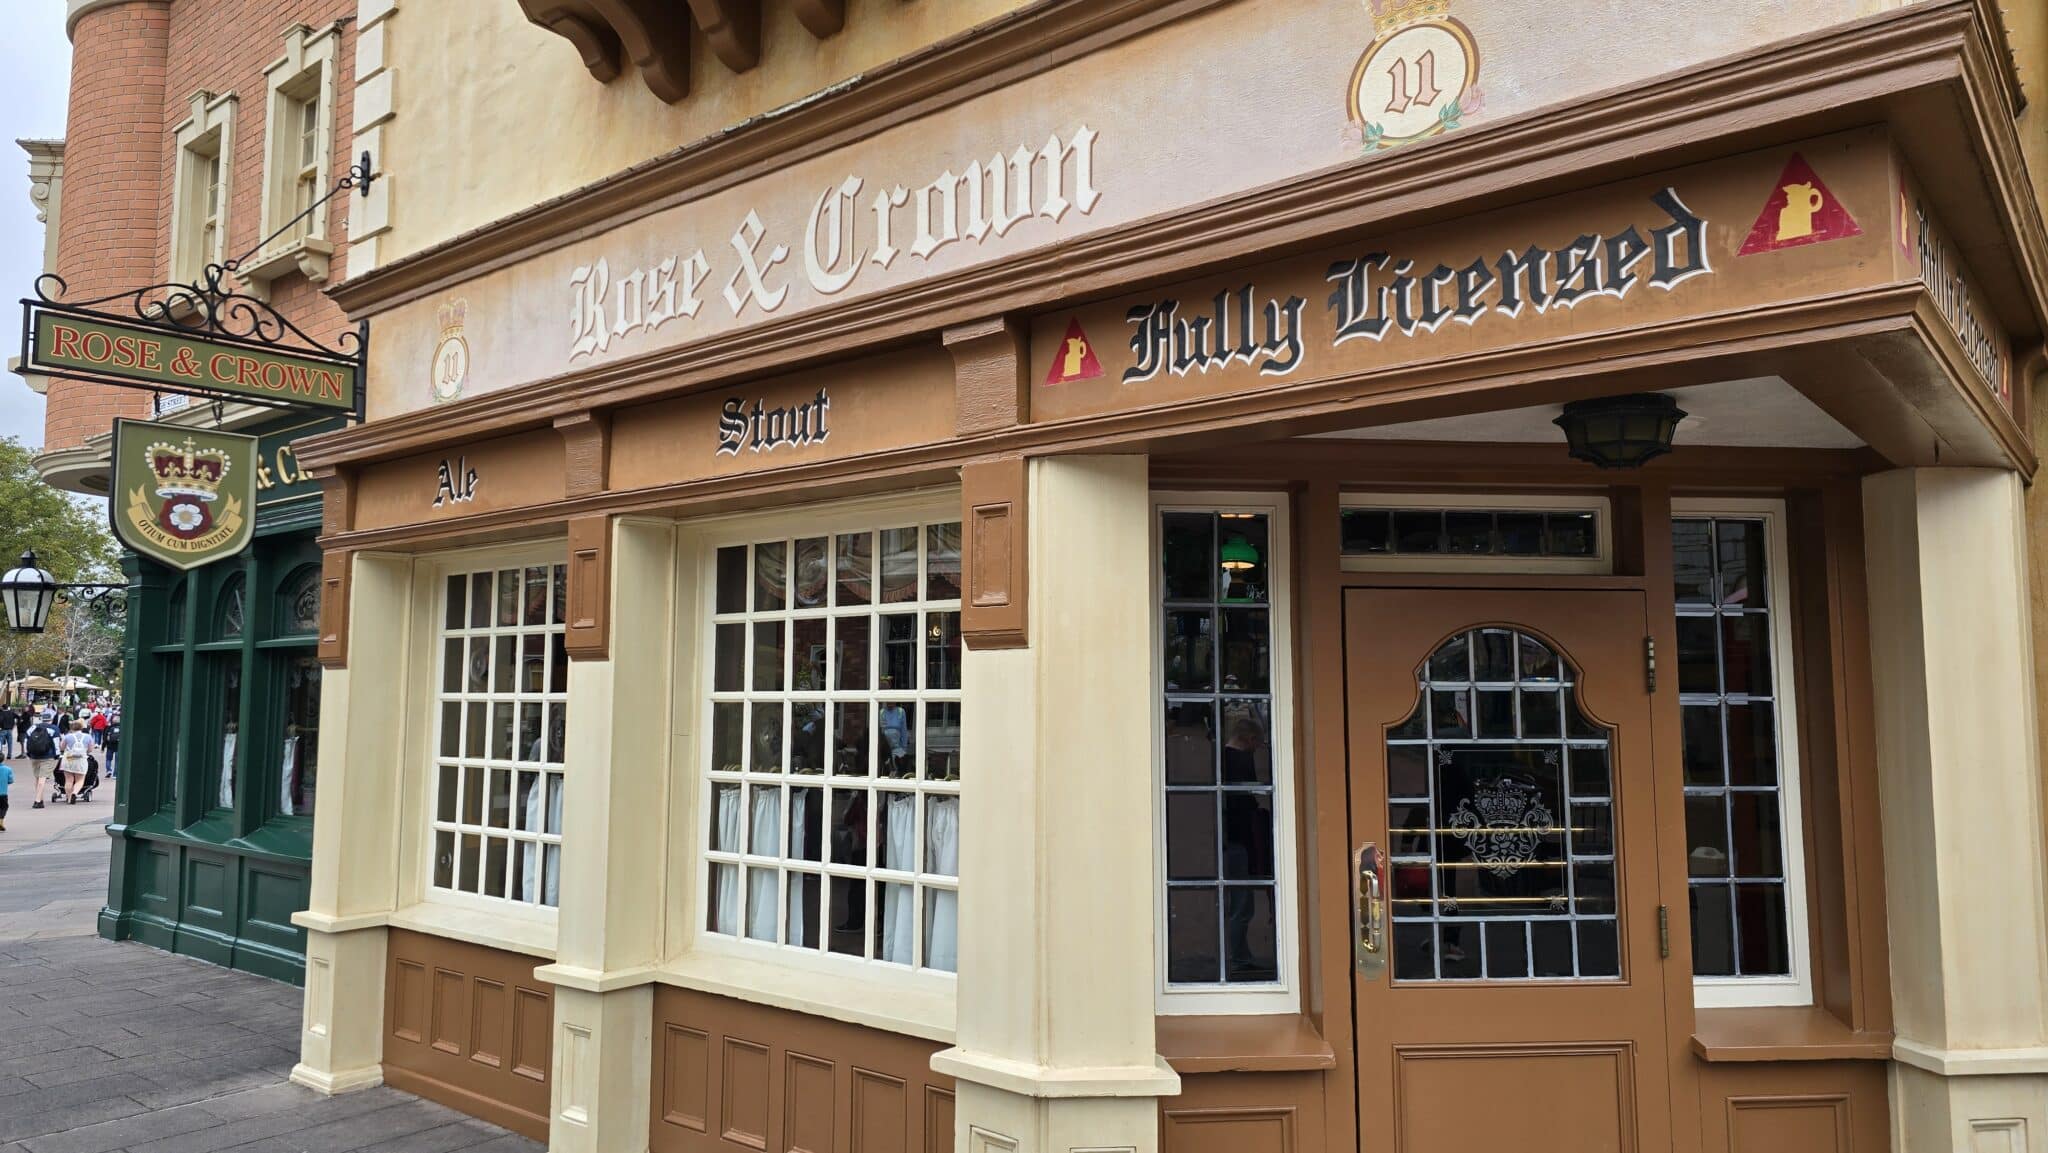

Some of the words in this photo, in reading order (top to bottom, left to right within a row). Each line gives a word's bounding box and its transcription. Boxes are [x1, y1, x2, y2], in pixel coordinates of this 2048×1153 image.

[569, 248, 711, 363] Rose
[723, 208, 790, 318] &
[805, 124, 1102, 295] Crown
[1122, 282, 1307, 384] Fully
[1326, 187, 1713, 347] Licensed
[51, 324, 162, 372] ROSE
[170, 346, 201, 378] &
[209, 352, 345, 400] CROWN
[715, 386, 831, 457] Stout
[431, 455, 480, 508] Ale
[138, 519, 166, 543] OTIUM
[166, 538, 188, 550] CUM
[190, 525, 235, 550] DIGNITATE
